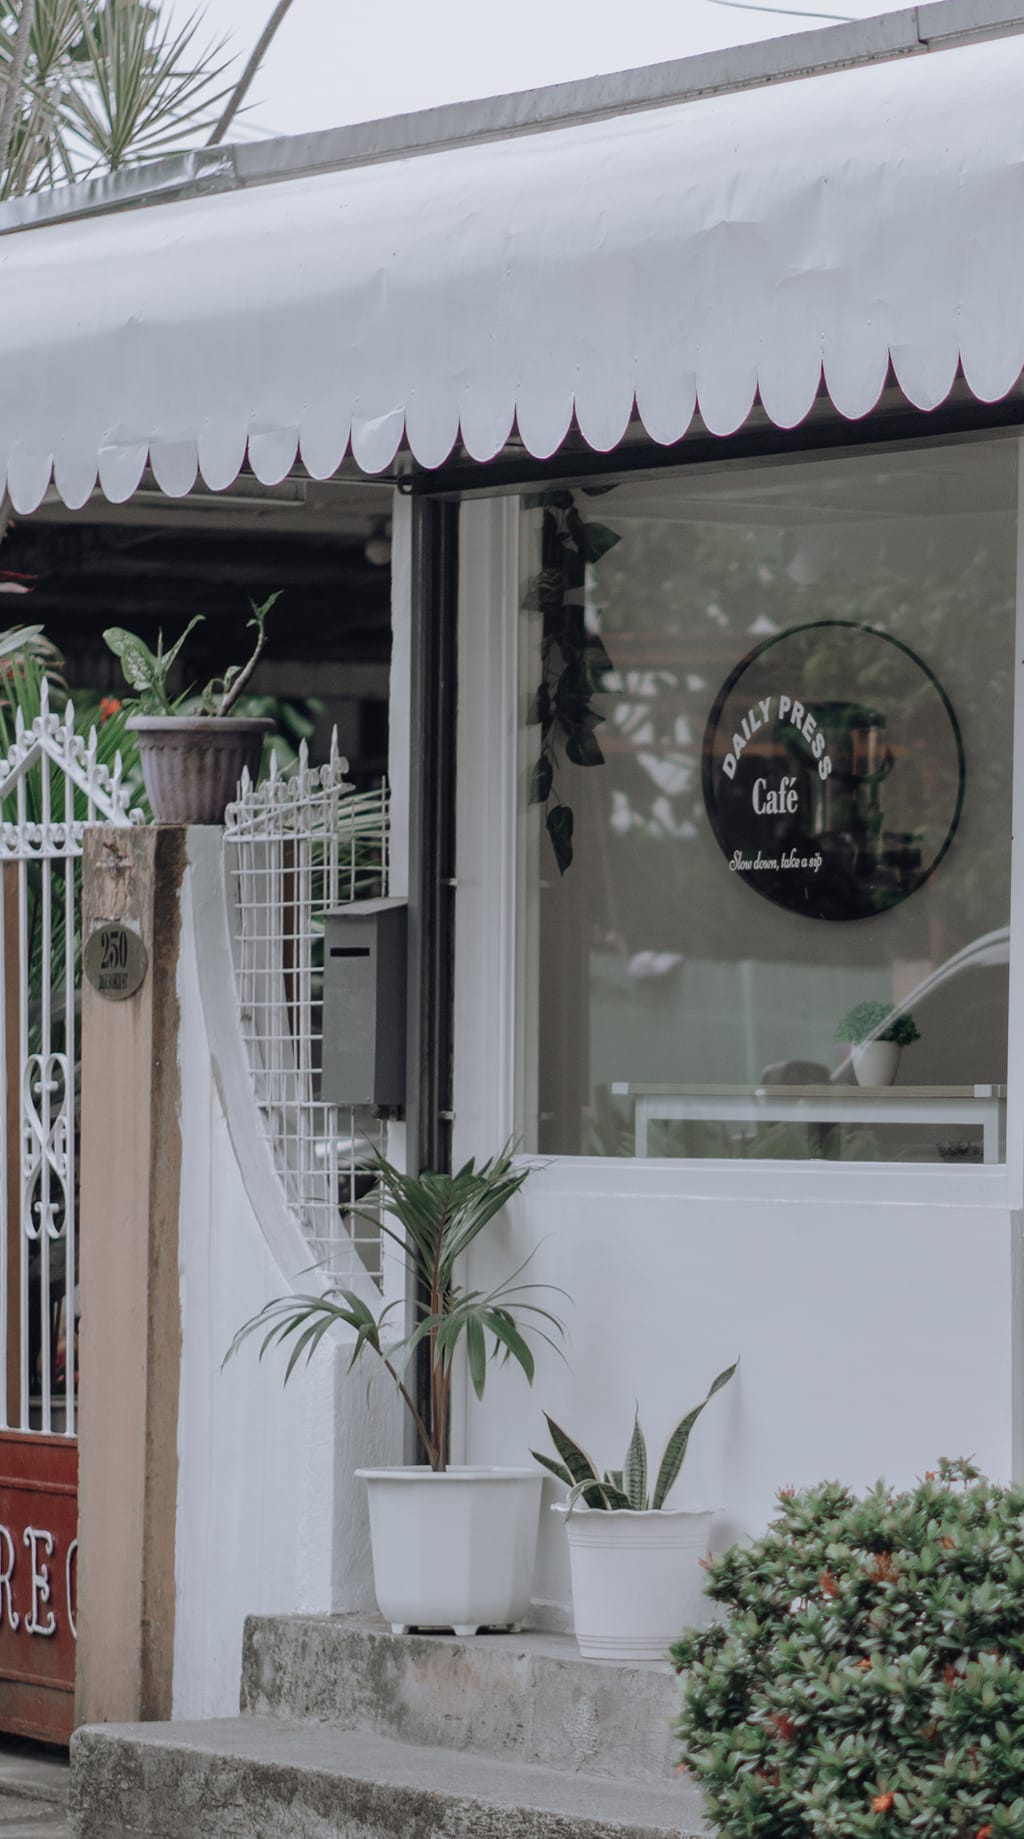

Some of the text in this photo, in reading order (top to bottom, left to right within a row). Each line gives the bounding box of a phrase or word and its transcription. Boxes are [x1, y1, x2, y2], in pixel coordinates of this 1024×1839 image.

[722, 695, 832, 781] DAILY PRESS
[751, 777, 798, 815] Café
[728, 847, 823, 873] Slow down, take a sip
[100, 930, 128, 969] 250
